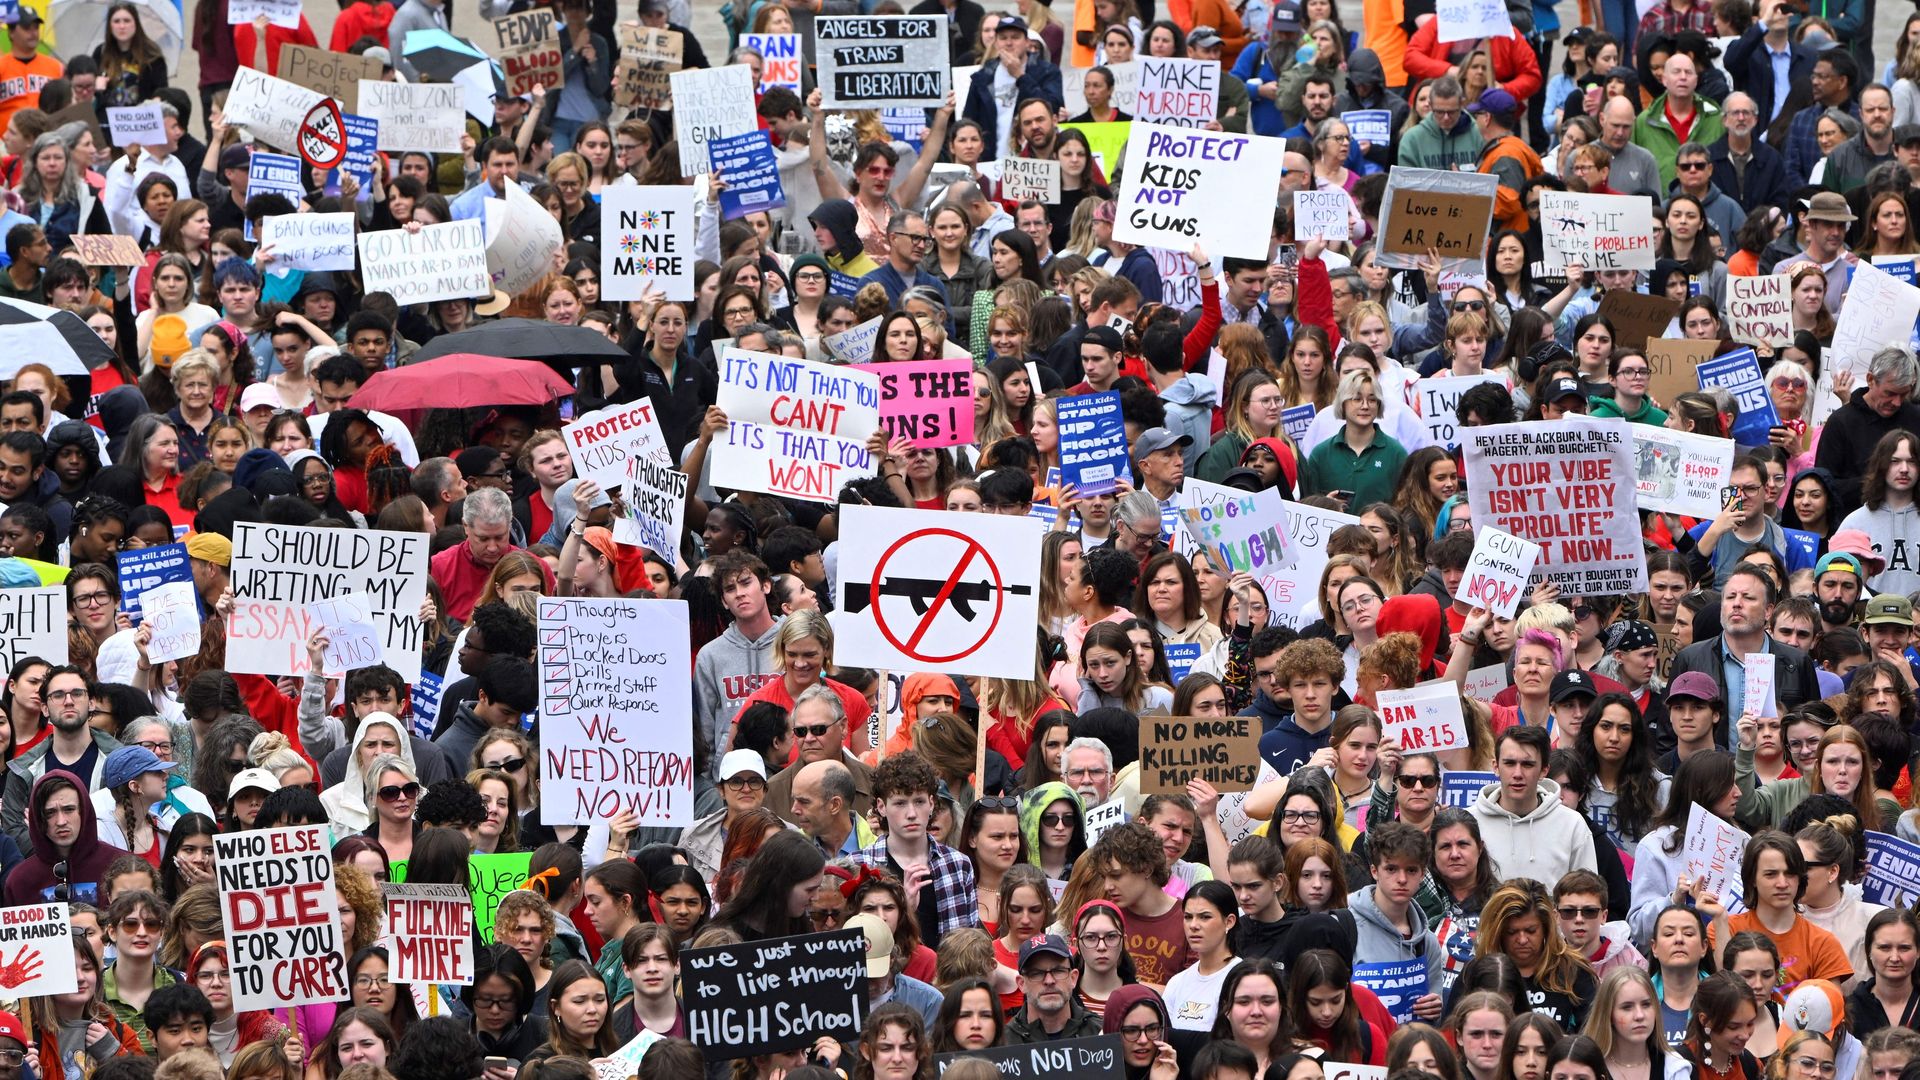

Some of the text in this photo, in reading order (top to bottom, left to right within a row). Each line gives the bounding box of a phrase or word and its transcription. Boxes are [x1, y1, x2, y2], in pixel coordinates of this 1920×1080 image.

[820, 20, 930, 38] ANGELS FOR
[633, 32, 668, 47] WE
[506, 51, 561, 76] BLOOD
[637, 58, 666, 70] WE
[838, 47, 898, 64] TRANS
[845, 73, 940, 96] LIBERATION
[1142, 62, 1214, 90] MAKE
[624, 83, 655, 97] NOW
[1137, 90, 1212, 116] MURDER
[135, 112, 154, 120] GUN
[115, 122, 159, 131] VIOLENCE
[692, 125, 722, 143] GUN
[713, 141, 767, 157] STAND
[1147, 131, 1249, 161] PROTECT
[715, 157, 749, 169] UP
[1005, 159, 1050, 175] PROTECT
[267, 167, 298, 183] ENDS
[719, 165, 774, 182] FIGHT
[1005, 173, 1050, 186] US NOT
[1140, 162, 1201, 190] KIDS
[1012, 187, 1049, 201] GUNS
[1134, 188, 1187, 206] NOT
[1300, 193, 1346, 208] PROTECT
[1406, 198, 1437, 216] Love
[1563, 200, 1579, 210] me
[620, 210, 675, 229] NOT
[1130, 209, 1201, 237] GUNS.
[1313, 210, 1338, 222] KIDS
[275, 220, 350, 238] BAN GUNS
[451, 225, 481, 249] OLD
[1303, 226, 1327, 237] NOT
[620, 234, 675, 253] ONE
[1572, 236, 1648, 251] the PROBLEM
[284, 245, 352, 262] NOT BOOKS
[1595, 252, 1621, 268] ME
[366, 253, 485, 280] WANTS BAN
[614, 257, 682, 275] MORE
[437, 274, 485, 293] MUCH
[1734, 279, 1781, 299] GUN
[1731, 301, 1789, 319] CONTROL
[1735, 322, 1789, 339] NOW
[843, 343, 869, 359] NOW
[724, 357, 878, 411] IT'S NOT THAT YOU
[909, 371, 970, 398] THE
[1095, 396, 1115, 404] Kids.
[1059, 405, 1117, 419] STAND
[573, 405, 652, 448] PROTECT
[1060, 422, 1095, 435] UP
[1430, 423, 1454, 441] TO
[728, 421, 871, 470] IT'S THAT YOU
[1061, 433, 1122, 451] FIGHT
[1476, 431, 1622, 446] HEY LEE, BLACKBURN, OGLES,
[580, 434, 650, 472] KIDS not
[1062, 445, 1125, 464] BACK
[1484, 444, 1555, 457] HAGERTY, AND
[1688, 453, 1721, 464] YOU HAVE
[635, 454, 687, 499] THOUGHTS
[1490, 459, 1612, 487] YOUR VIBE
[1685, 464, 1718, 478] BLOOD
[1684, 479, 1717, 490] ON YOUR
[1489, 483, 1616, 513] ISN'T VERY
[1688, 489, 1711, 499] HANDS
[633, 484, 674, 526] PRAYERS
[1180, 496, 1256, 523] ENOUGH
[1202, 523, 1221, 540] IS
[142, 551, 159, 560] Kill.
[160, 548, 182, 558] Kids.
[235, 525, 417, 575] I SHOULD BE
[1489, 533, 1524, 559] GUN
[121, 557, 184, 575] STAND
[1474, 552, 1524, 579] CONTROL
[122, 575, 162, 592] UP
[1548, 568, 1639, 583] AREN'T BOUGHT BY
[366, 578, 408, 610] MY
[1468, 573, 1518, 610] NOW
[1557, 580, 1632, 595] SAVE OUR KIDS!
[565, 600, 637, 628] Thoughts
[229, 603, 424, 651] ESSAY MY
[330, 627, 347, 638] THE
[569, 626, 628, 651] Prayers
[323, 636, 375, 668] GUNS
[572, 647, 667, 665] Locked Doors
[575, 662, 612, 680] Drills
[575, 676, 658, 694] Armed Staff
[570, 694, 659, 712] Quick Response
[1383, 705, 1416, 724] BAN
[577, 713, 626, 744] We
[1155, 720, 1249, 743] NO MORE
[1400, 724, 1455, 751] AR-15
[1143, 743, 1229, 771] KILLING
[548, 745, 692, 791] NEED REFORM
[1446, 790, 1463, 805] IT
[215, 829, 321, 860] WHO ELSE
[219, 854, 330, 891] NEEDS TO
[2, 907, 60, 925] BLOOD IS
[227, 882, 331, 933] DIE
[388, 899, 473, 936] FUCKING
[21, 923, 67, 940] HANDS
[232, 924, 334, 964] FOR YOU
[804, 935, 865, 955] want
[396, 936, 465, 981] MORE
[233, 951, 348, 1001] TO CARE?
[1355, 963, 1425, 977] Guns. Kill. Kids.
[697, 961, 867, 998] to live through
[689, 1005, 769, 1046] HIGH
[1079, 1048, 1113, 1070] Drag
